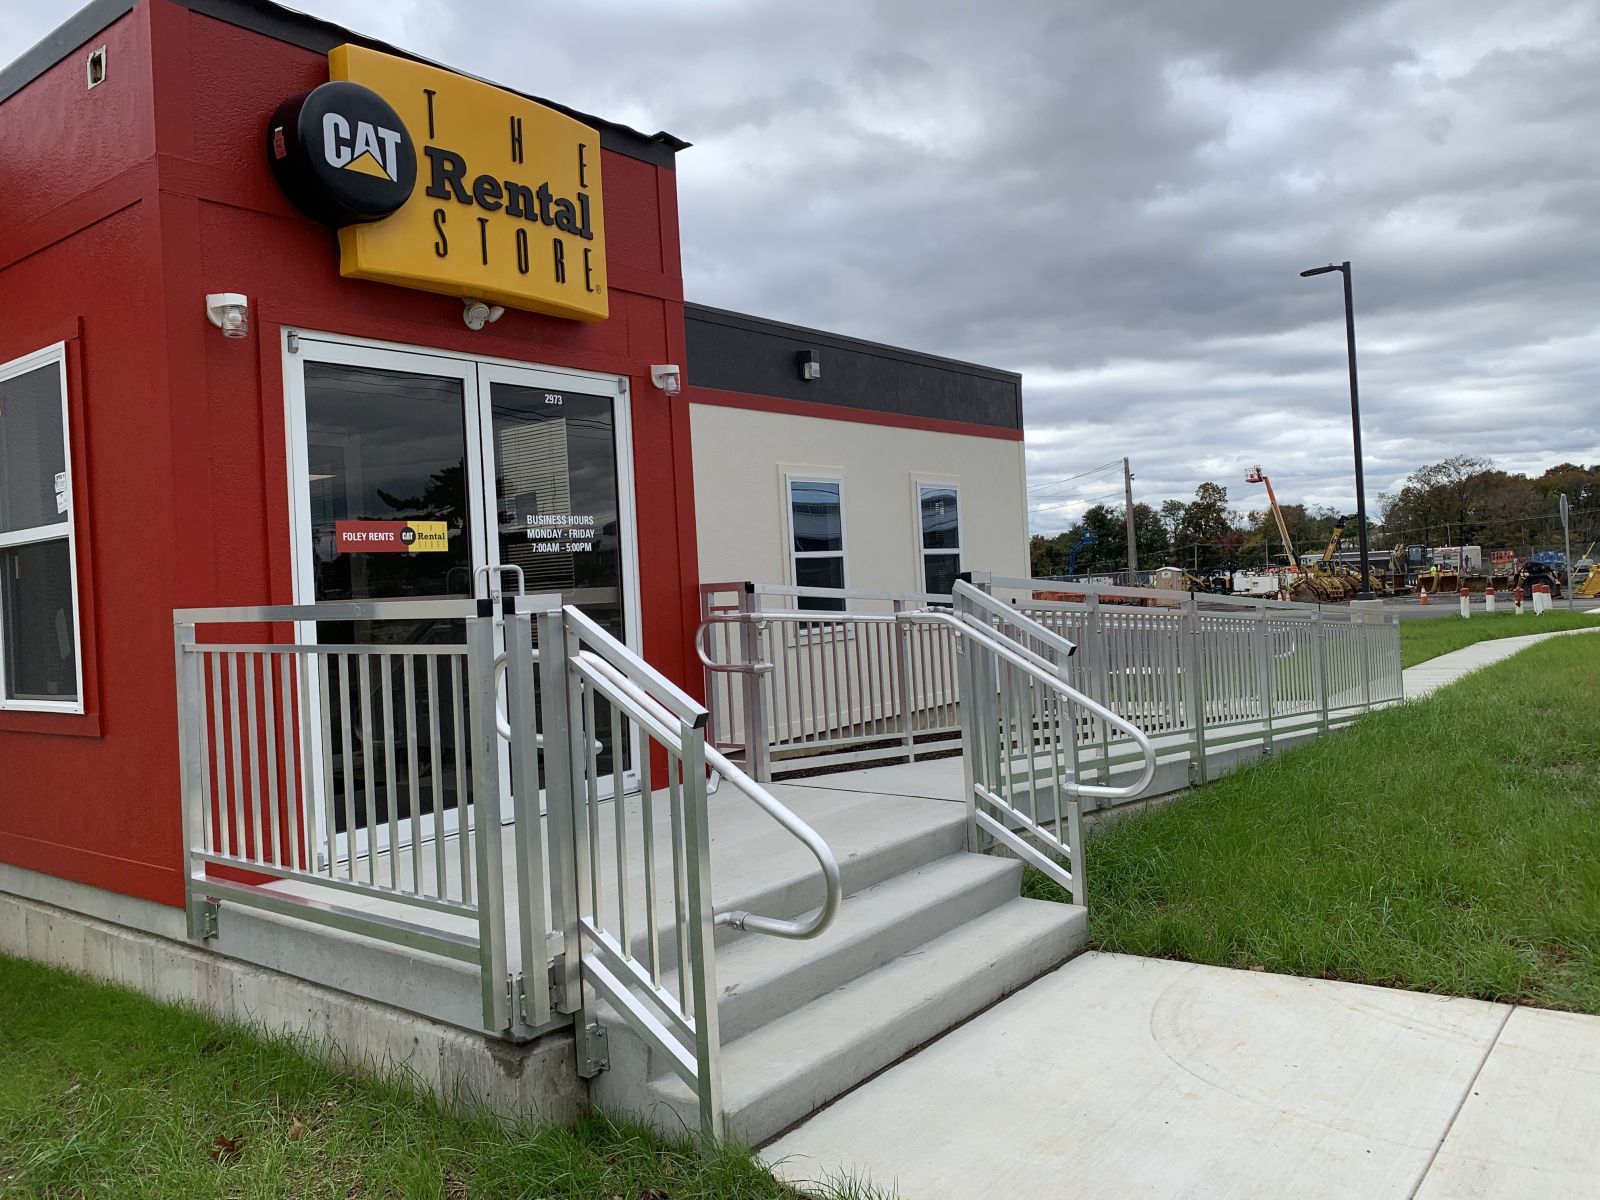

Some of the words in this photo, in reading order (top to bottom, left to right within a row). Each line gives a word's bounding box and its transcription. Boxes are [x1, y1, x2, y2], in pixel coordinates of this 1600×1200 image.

[322, 112, 401, 183] CAT
[424, 145, 594, 240] Rental
[544, 393, 563, 405] 2973
[527, 514, 567, 524] BUSINESS
[568, 515, 594, 525] HOURS
[343, 532, 367, 541] FOLEY
[368, 532, 395, 541] RENTS
[402, 532, 414, 540] CAT
[417, 532, 445, 540] Rental
[527, 529, 563, 539] MONDAY
[569, 529, 595, 539] FRIDAY
[532, 543, 560, 553] 7:00AM
[566, 543, 592, 552] 5:00PM
